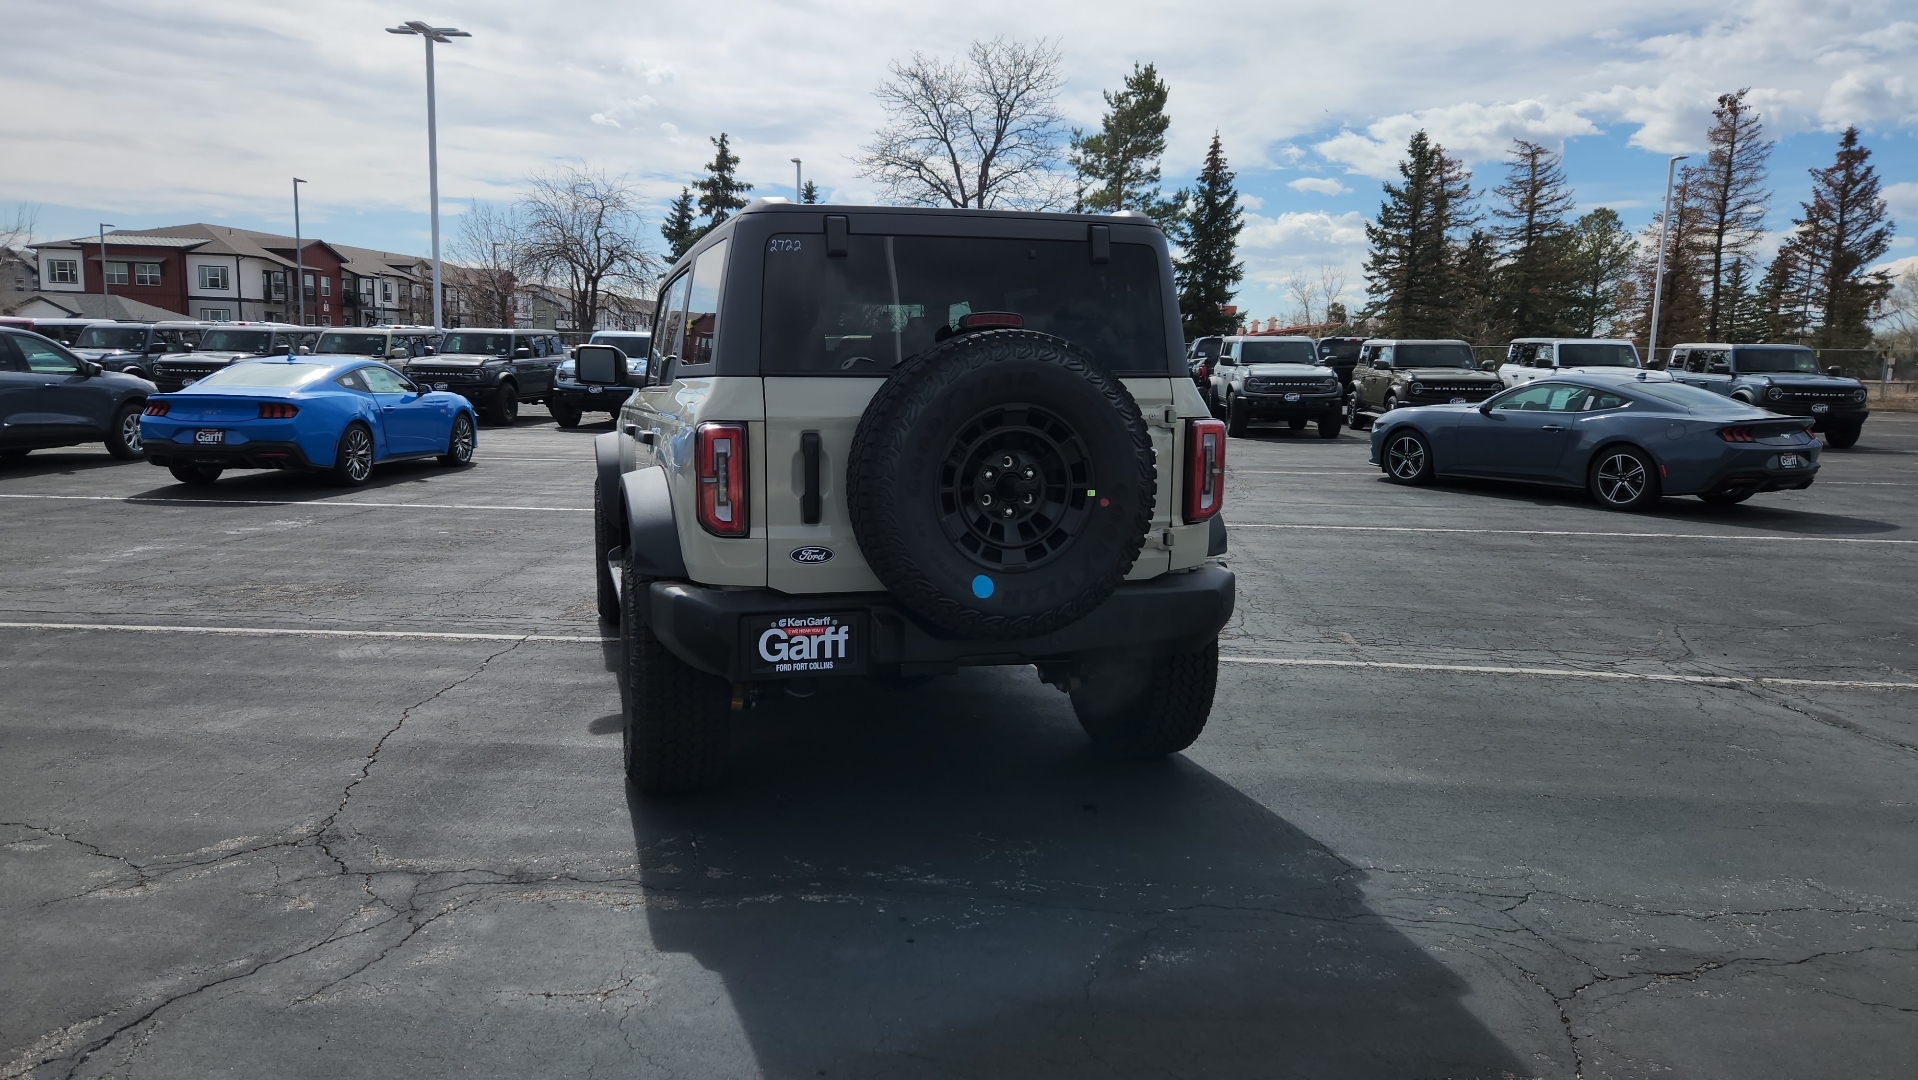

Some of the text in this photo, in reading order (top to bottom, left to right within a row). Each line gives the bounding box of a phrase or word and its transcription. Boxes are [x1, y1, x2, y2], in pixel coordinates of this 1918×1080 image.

[770, 239, 802, 251] 2722
[196, 431, 223, 442] Garff
[1781, 454, 1797, 466] Garff
[799, 549, 826, 560] Ford
[788, 617, 831, 627] Ken Garff
[758, 626, 849, 662] Garff
[776, 661, 834, 672] FORD FORT COLLINS
